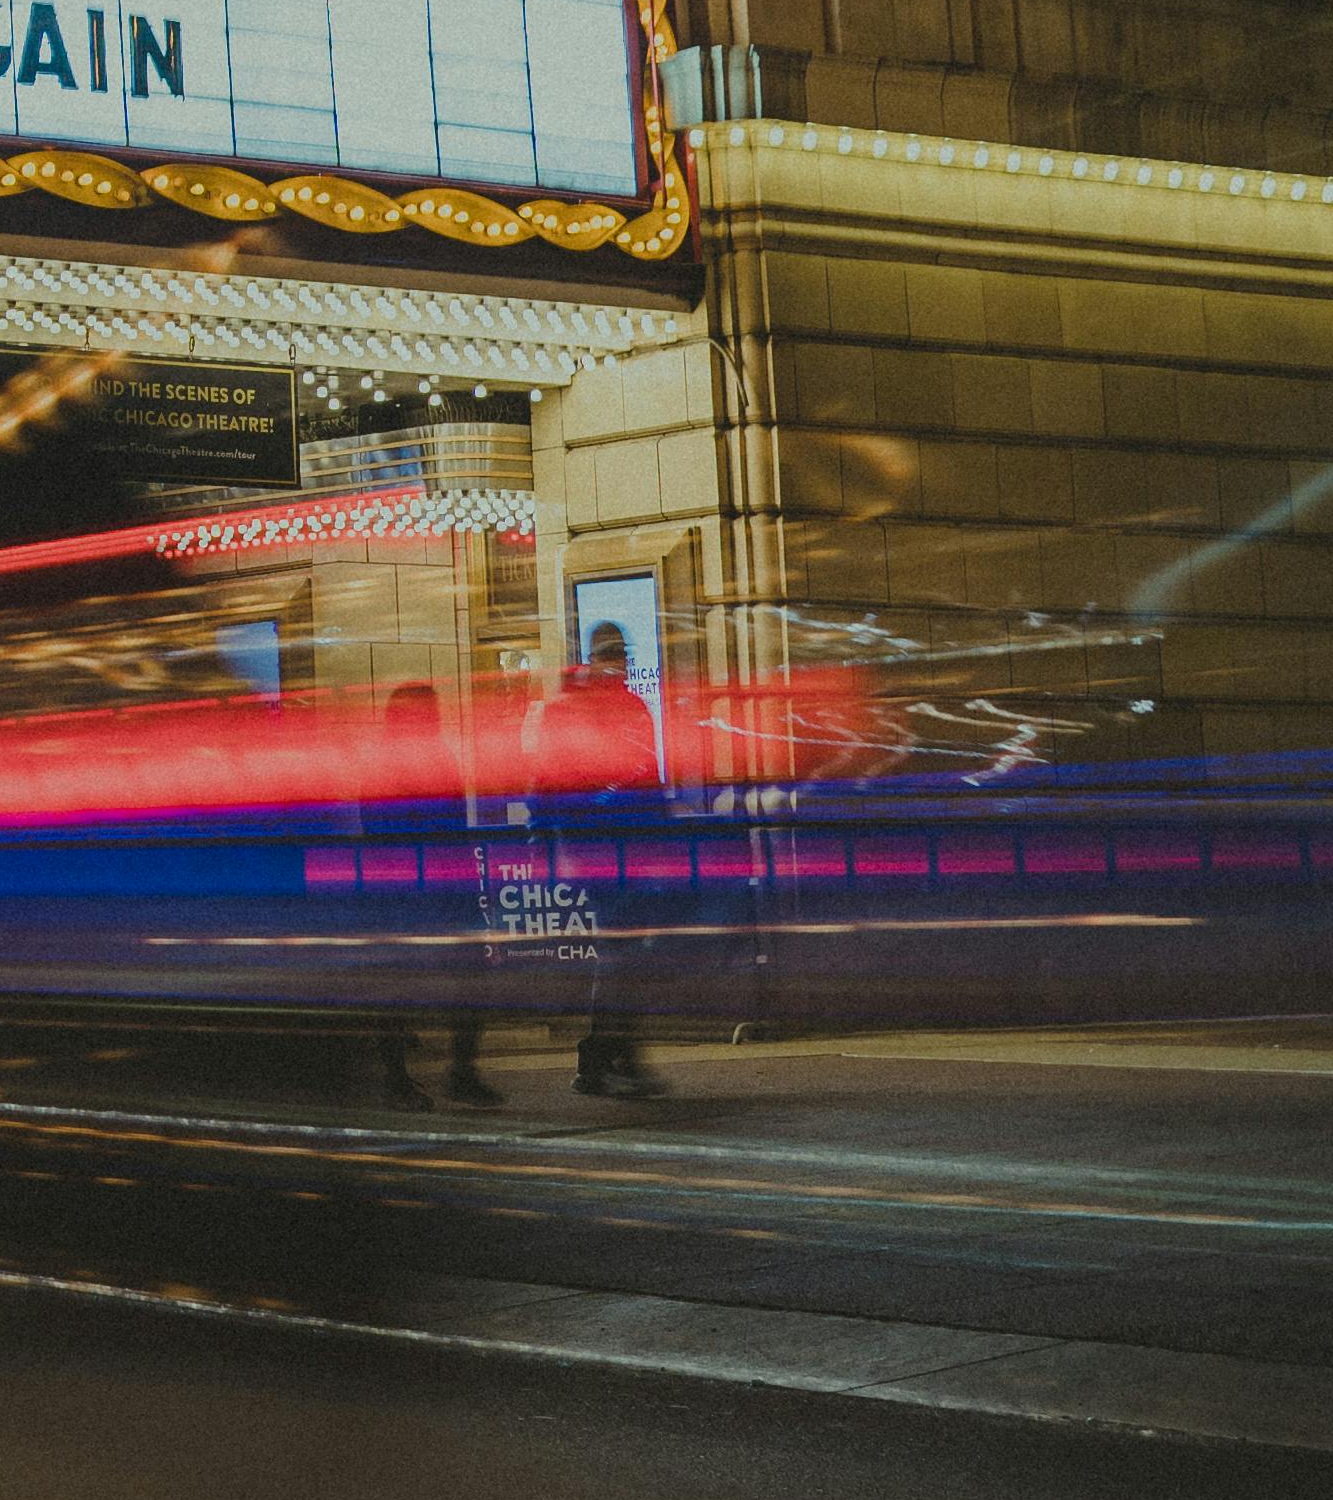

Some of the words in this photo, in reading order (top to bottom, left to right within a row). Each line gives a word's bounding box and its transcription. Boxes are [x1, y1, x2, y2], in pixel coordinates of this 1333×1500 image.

[129, 382, 161, 400] THE
[166, 384, 229, 403] SCENES
[233, 387, 256, 405] OF
[114, 409, 192, 429] CHICAGO
[197, 413, 274, 433] THEATRE!
